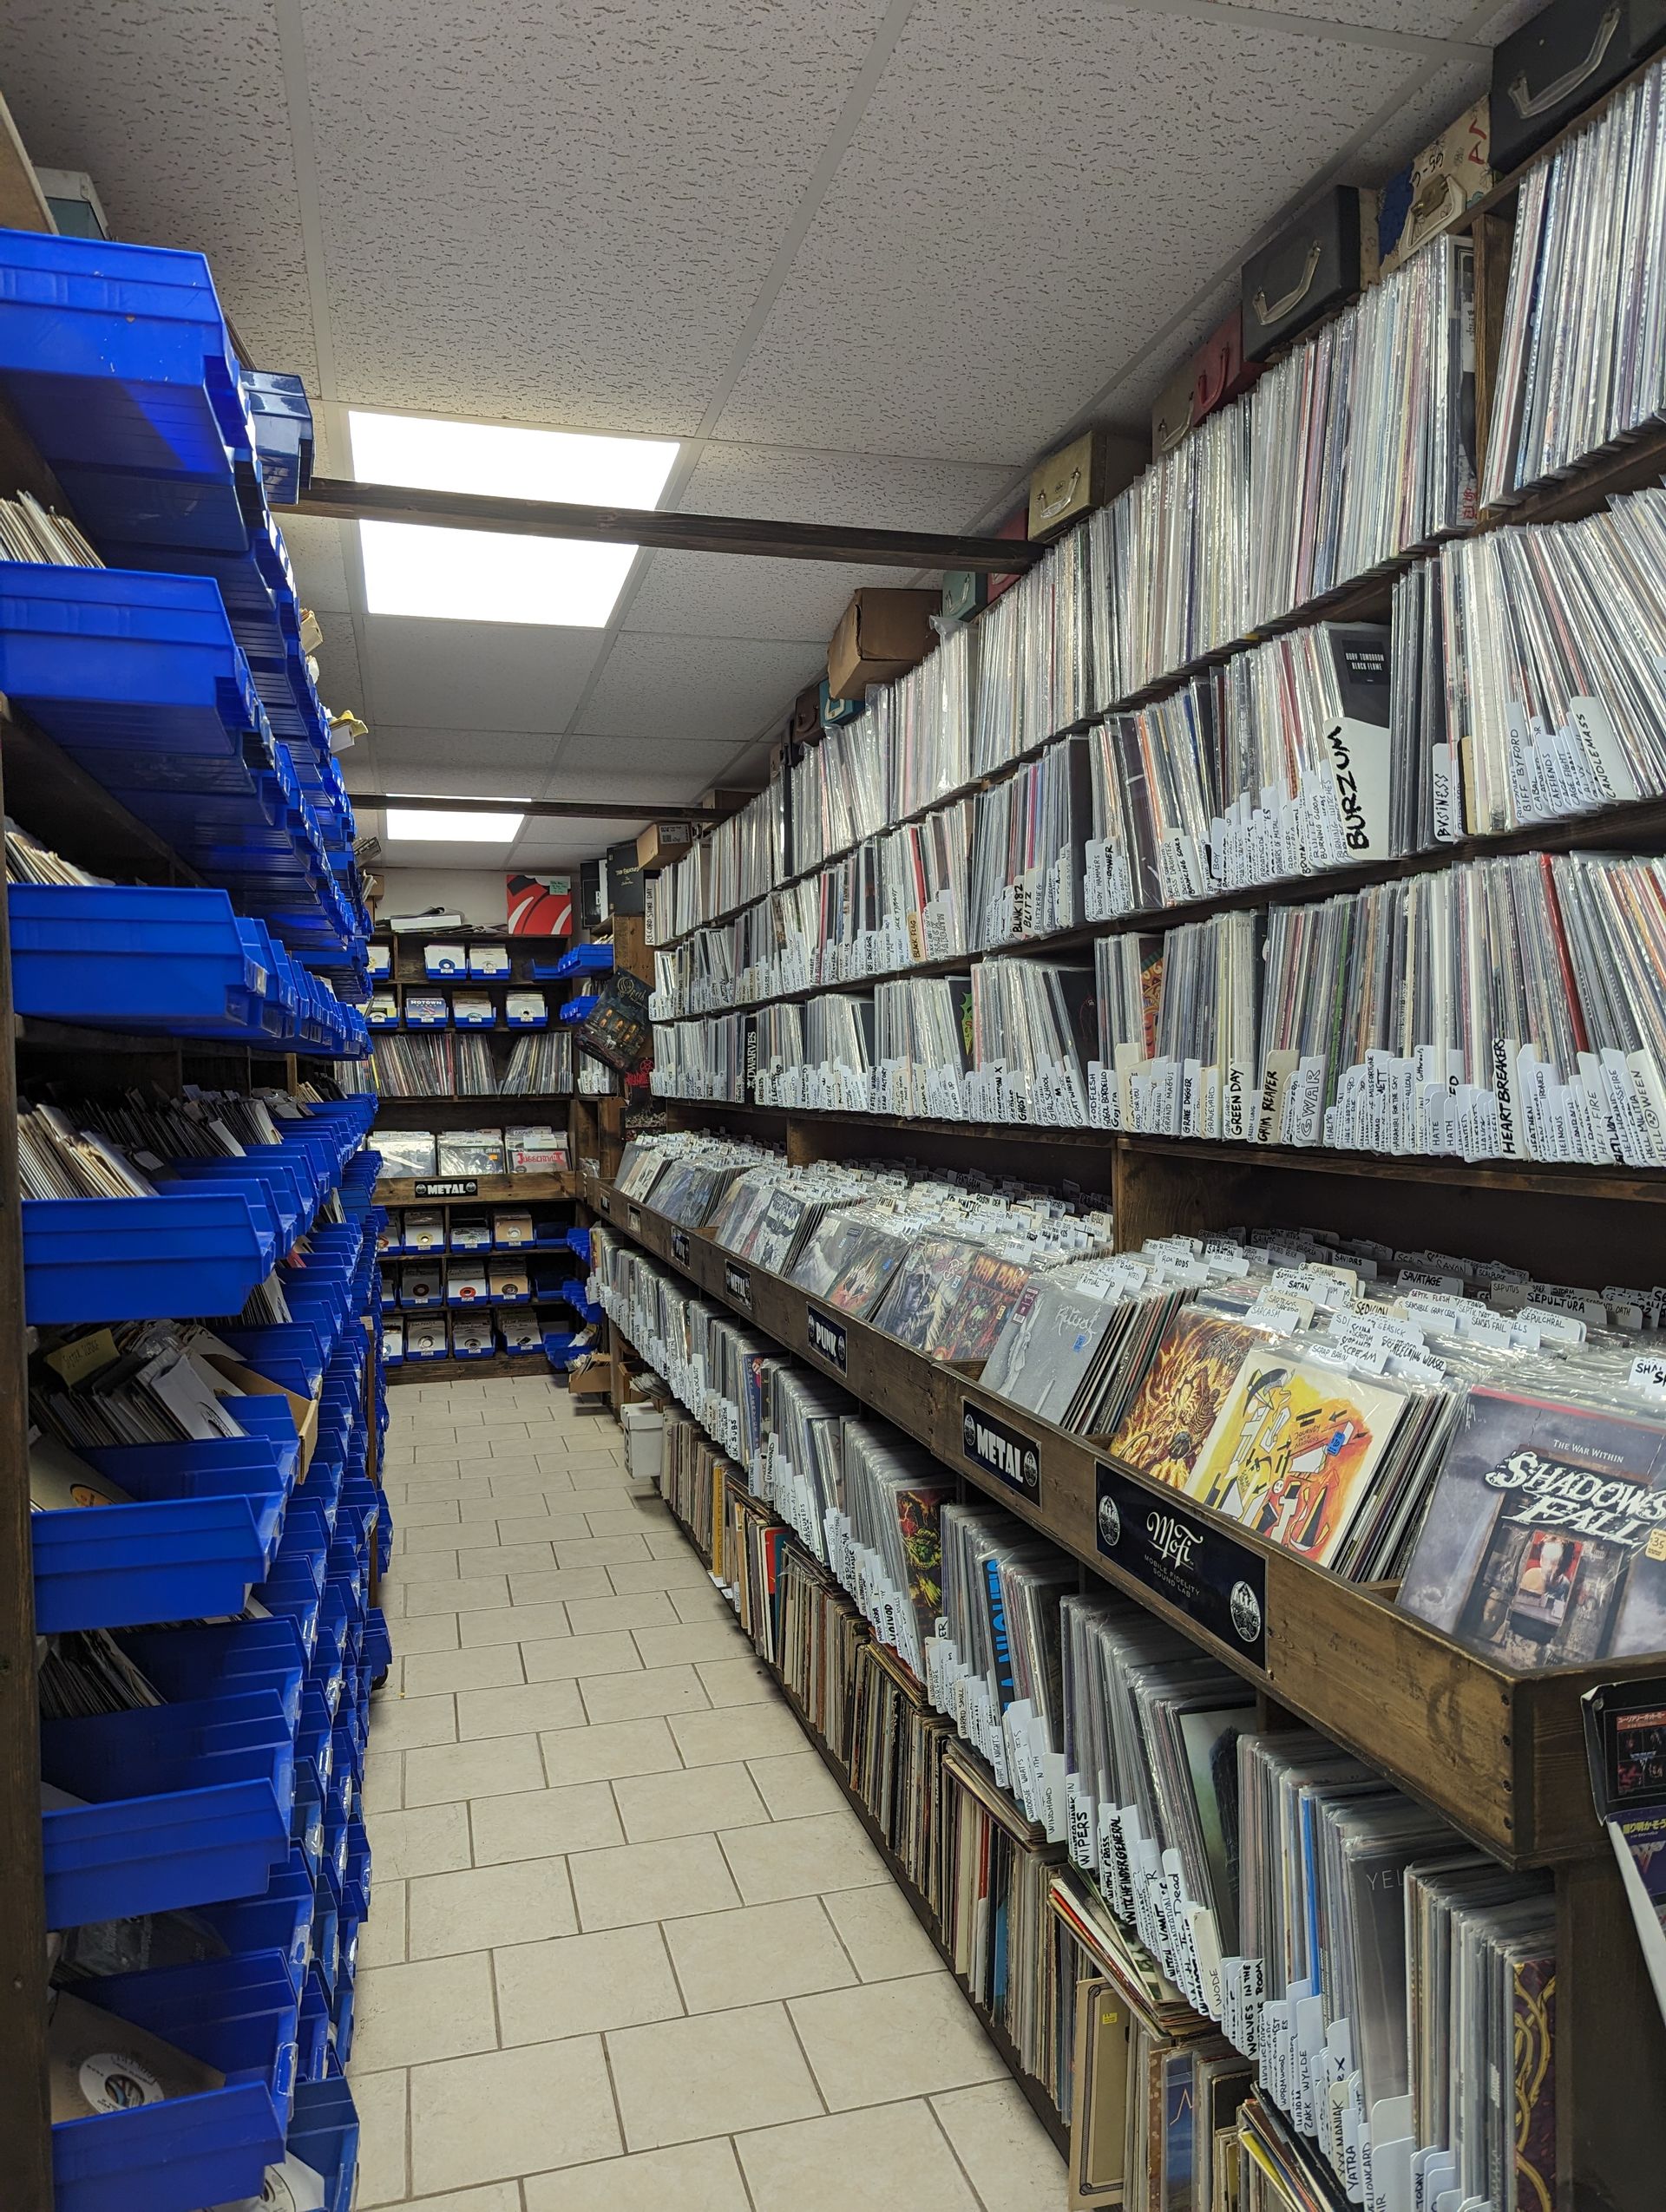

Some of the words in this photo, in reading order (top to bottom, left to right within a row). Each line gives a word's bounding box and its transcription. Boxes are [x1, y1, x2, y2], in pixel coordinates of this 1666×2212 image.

[1511, 729, 1525, 782] BYFORD
[1577, 714, 1616, 798] CANDLEMASS
[1326, 724, 1371, 852] BURZUM
[1519, 785, 1532, 812] BIFF
[1316, 824, 1328, 859] BURNING
[1213, 852, 1222, 870] BOY
[1180, 860, 1195, 894] BOUNCING
[1013, 883, 1024, 903] 182
[1033, 883, 1042, 931] BLITZKRIEG
[1013, 906, 1023, 933] BLINK
[1023, 891, 1033, 928] BLITZ
[646, 919, 654, 945] RECORD
[912, 938, 921, 958] BLACK
[747, 1031, 758, 1083] DWARVES
[881, 1067, 889, 1094] FACTORY
[1100, 1070, 1110, 1104] BORDELLO
[1184, 1077, 1193, 1104] DIGGER
[1230, 1068, 1245, 1094] DAY
[1263, 1070, 1279, 1112] REAPER
[1493, 1037, 1517, 1155] HEARTBREAKERS
[1015, 1091, 1028, 1122] GHOST
[1042, 1073, 1057, 1122] GIRLSCHOOL
[1065, 1076, 1084, 1125] GOATWHORE
[1302, 1069, 1322, 1137] GWAR
[1101, 1105, 1112, 1128] GOGOL
[1183, 1109, 1192, 1134] GRAVE
[1230, 1095, 1243, 1135] GREEN
[1257, 1116, 1272, 1142] GRIM
[1392, 1117, 1400, 1151] HARAKIRI
[1432, 1121, 1440, 1146] HATE
[1445, 1120, 1454, 1146] HATH
[1555, 1116, 1569, 1156] HEINOUS
[427, 1183, 467, 1195] METAL
[1174, 1259, 1190, 1269] RODS
[1311, 1265, 1337, 1278] SATHANAS
[1335, 1253, 1363, 1266] SAVIOURS
[1287, 1279, 1312, 1293] SATAN
[1401, 1271, 1444, 1287] SAVATAGE
[1492, 1283, 1520, 1294] SEPUTUS
[1404, 1299, 1430, 1312] SENSIBLE
[1411, 1289, 1429, 1300] SEPTIC
[1432, 1293, 1452, 1304] FLESH
[1525, 1291, 1586, 1314] SEPULTURA
[1250, 1306, 1282, 1319] SARCASM
[1471, 1315, 1492, 1330] SENSES
[1491, 1321, 1508, 1334] FAIL
[1520, 1311, 1565, 1329] SEPULCHRAL
[816, 1321, 837, 1358] PUNK
[1377, 1321, 1407, 1337] SEASICK
[1311, 1345, 1331, 1358] SCRAP
[1330, 1349, 1349, 1362] BRAIN
[1421, 1353, 1446, 1372] WEASEL
[1293, 1424, 1322, 1440] JOURNEY
[1294, 1436, 1320, 1448] MADNESS
[976, 1423, 1023, 1484] METAL
[1553, 1439, 1571, 1450] THE
[1572, 1443, 1590, 1456] WAR
[1592, 1448, 1624, 1464] WITHIN
[1485, 1450, 1666, 1519] SHADOWS
[1501, 1494, 1651, 1548] FALL
[1146, 1511, 1204, 1571] MoFi
[1145, 1554, 1168, 1574] MOBILE
[1170, 1571, 1200, 1597] FIDELITY
[1152, 1567, 1176, 1587] SOUND
[1177, 1584, 1191, 1598] LAB
[884, 1603, 896, 1641] VOIVOD
[931, 1669, 943, 1713] WARFARE
[959, 1710, 968, 1736] WARPED
[1046, 1787, 1056, 1835] WINDHAND
[1076, 1811, 1091, 1866] WIPERS
[1210, 1969, 1223, 2008] WODE
[1243, 1964, 1252, 1983] THE
[1255, 1960, 1264, 1997] ROOM
[1243, 1984, 1253, 1997] IN
[1244, 2004, 1257, 2058] WOLVES
[1276, 2054, 1287, 2107] WORMWOOD
[1299, 2050, 1311, 2092] WYLDE
[1303, 2101, 1314, 2132] ZAKK
[1346, 2144, 1360, 2193] YATRA
[1414, 2172, 1425, 2207] TODAY
